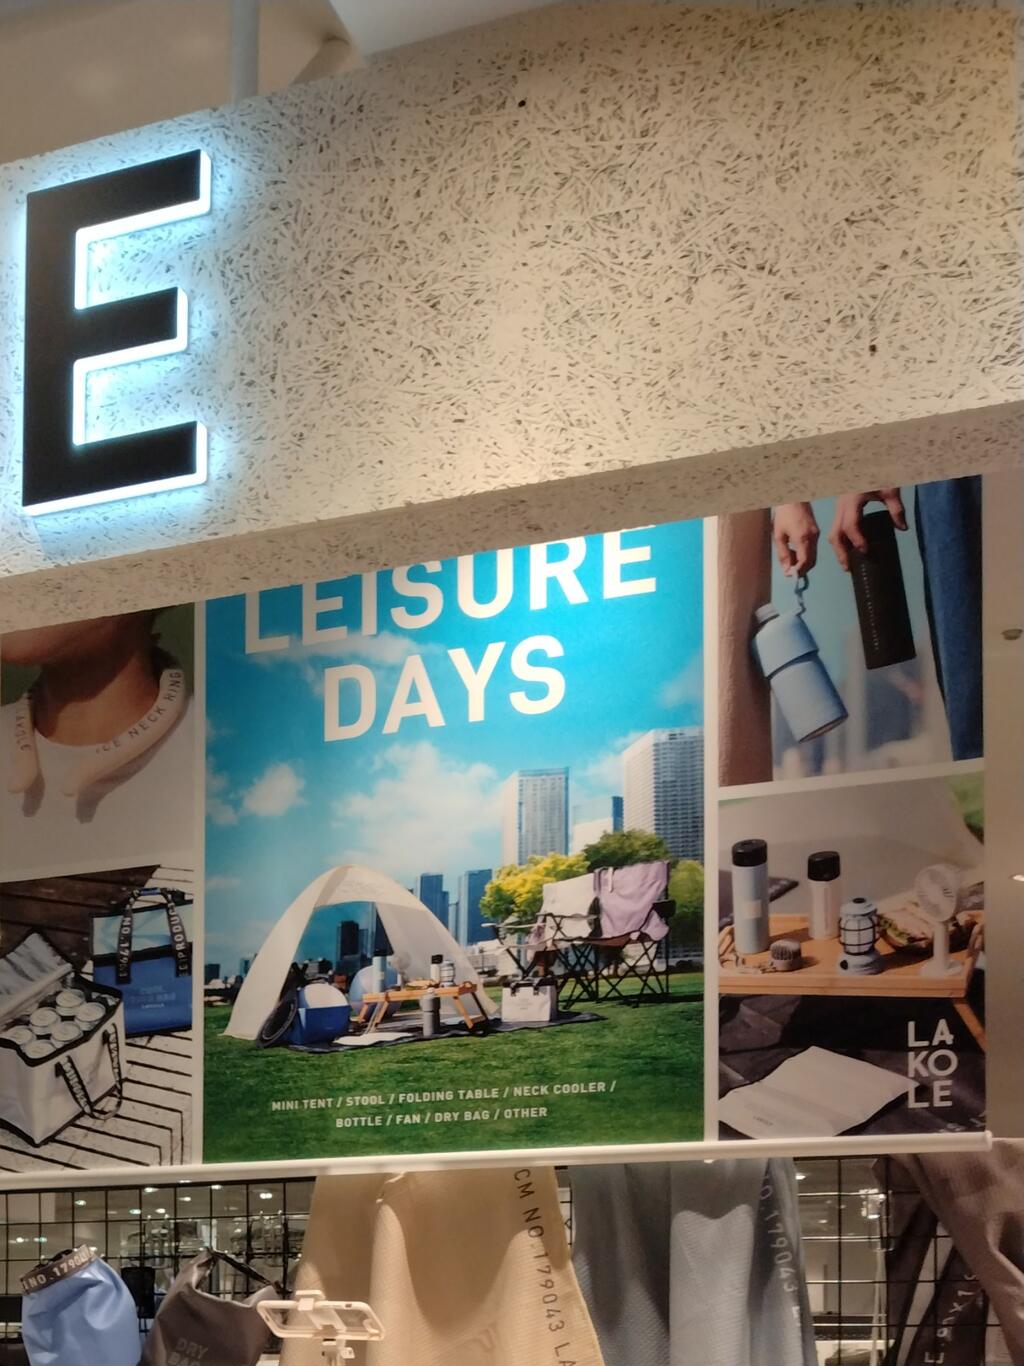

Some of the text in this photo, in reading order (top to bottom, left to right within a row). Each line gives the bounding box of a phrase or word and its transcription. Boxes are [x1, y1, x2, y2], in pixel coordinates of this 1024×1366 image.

[245, 524, 656, 654] LEISURE
[323, 635, 566, 742] DAYS
[129, 705, 167, 738] NECK
[908, 1018, 954, 1048] LA
[908, 1049, 958, 1078] KO
[272, 1100, 300, 1111] MINI
[303, 1098, 332, 1109] TENT
[346, 1095, 385, 1107] STOOL
[398, 1090, 454, 1104] FOLDING
[458, 1087, 500, 1101] TABLE
[513, 1084, 549, 1097] NECK
[553, 1082, 606, 1094] COOLER
[908, 1080, 953, 1109] LE
[336, 1115, 382, 1128] BOTTLE
[395, 1113, 421, 1125] FAN
[434, 1111, 459, 1123] DRY
[464, 1109, 490, 1121] BAG
[504, 1107, 547, 1119] OTHER
[514, 1169, 535, 1199] CM
[177, 1338, 208, 1360] DRY
